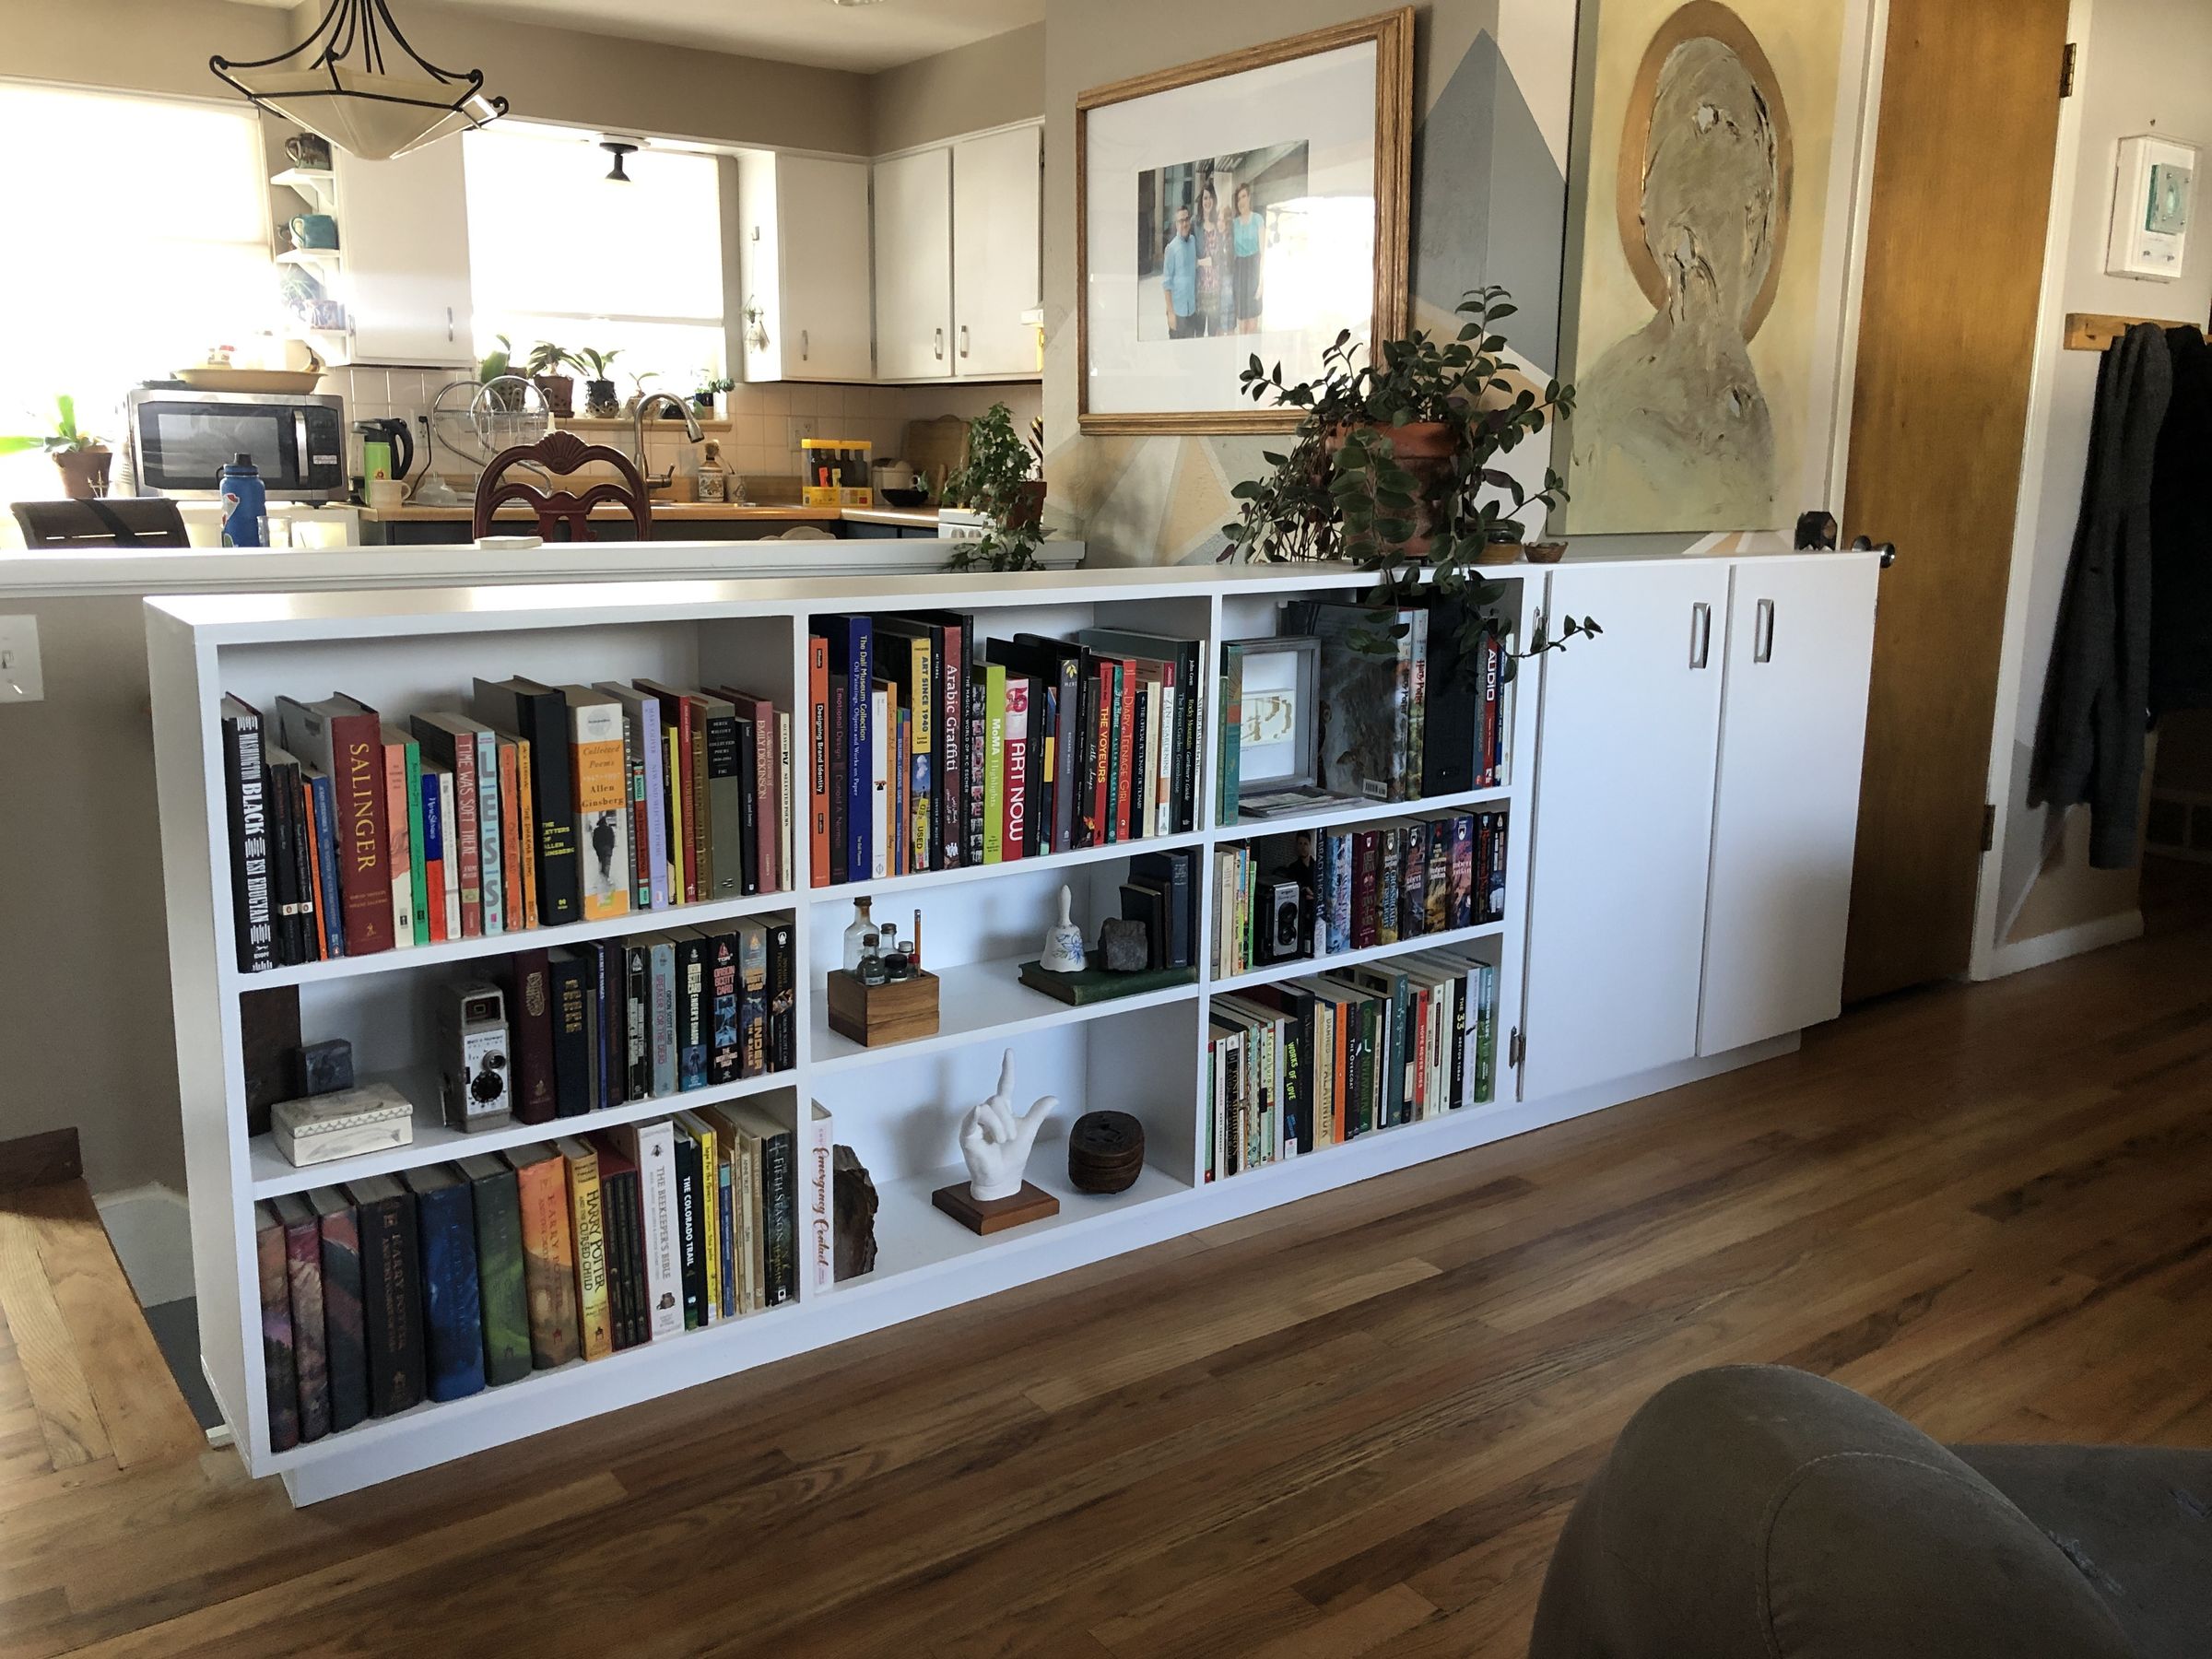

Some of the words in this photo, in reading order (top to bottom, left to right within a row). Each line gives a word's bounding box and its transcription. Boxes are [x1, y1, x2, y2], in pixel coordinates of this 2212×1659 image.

[859, 634, 868, 650] The
[921, 656, 930, 677] ART
[1416, 659, 1426, 681] Harry
[1486, 648, 1496, 701] AUDIO
[859, 667, 867, 702] Museum
[921, 677, 930, 707] SINCE
[946, 664, 959, 713] Arabic
[1415, 681, 1425, 706] Potter
[835, 688, 845, 729] Emotional
[1100, 706, 1110, 728] THE
[1163, 699, 1174, 719] ZEN
[1177, 706, 1185, 728] Forest
[1184, 699, 1194, 718] Rocky
[1400, 690, 1409, 715] Potter
[757, 720, 767, 747] EMILY
[816, 704, 825, 740] Designing
[859, 703, 868, 741] Collection
[921, 709, 930, 733] 1940
[1186, 719, 1194, 749] Mountain
[582, 744, 621, 756] Collected
[834, 730, 843, 759] Design
[946, 716, 959, 772] Graffiti
[991, 718, 1001, 756] MoMA
[1161, 725, 1172, 775] GARDENING
[1175, 728, 1183, 753] Garden
[239, 733, 262, 780] WASHINGTON
[458, 742, 473, 768] TIME
[588, 759, 615, 769] Poems
[782, 751, 790, 766] PAZ
[817, 741, 825, 763] Brand
[1010, 742, 1027, 783] ART
[1098, 732, 1109, 783] VOYEURS
[1120, 733, 1133, 777] TEENAGE
[1184, 750, 1193, 783] Gardener's
[459, 771, 475, 795] WAS
[635, 776, 643, 799] KINNELL
[758, 747, 769, 800] DICKINSON
[816, 764, 825, 793] Identity
[989, 759, 1000, 808] Highlights
[1174, 753, 1182, 794] Greenhouse
[581, 795, 624, 808] Ginsberg
[589, 783, 615, 794] Allen
[835, 773, 844, 805] Donald
[1119, 779, 1131, 804] GIRL
[241, 782, 265, 835] BLACK
[349, 743, 376, 872] SALINGER
[460, 798, 476, 824] SOFT
[1008, 787, 1025, 842] NOW
[462, 829, 477, 857] THERE
[916, 826, 925, 850] USED
[246, 859, 267, 876] ESI
[1317, 841, 1325, 871] BRAD
[247, 877, 269, 923] EDUGYAN
[1317, 871, 1325, 901] THOR
[1389, 869, 1397, 927] CROSSROADS
[655, 973, 665, 1008] SPEAKER
[714, 975, 735, 986] SCOTT
[716, 984, 734, 995] CARD
[656, 1009, 665, 1026] FOR
[689, 994, 699, 1020] ENDER'S
[1456, 1013, 1465, 1030] 33
[657, 1027, 665, 1042] THE
[754, 1017, 764, 1070] ENDER
[657, 1043, 665, 1065] DEAD
[1288, 1041, 1299, 1068] WORKS
[1288, 1070, 1297, 1080] OF
[1347, 1054, 1356, 1090] OVERCOAT
[1286, 1081, 1297, 1101] LOVE
[704, 1147, 712, 1161] hope
[656, 1165, 665, 1188] THE
[682, 1176, 691, 1194] THE
[772, 1157, 786, 1192] FIFTH
[812, 1146, 830, 1215] Emergency
[586, 1189, 603, 1236] HARRY
[657, 1189, 670, 1253] BEEKEEPER'S
[684, 1194, 694, 1241] COLORADO
[774, 1193, 786, 1242] SEASON
[579, 1222, 591, 1259] CURSED
[686, 1241, 695, 1267] TRAIL
[812, 1218, 830, 1267] Contact
[582, 1261, 594, 1291] CHILD
[591, 1239, 606, 1293] POTTER
[661, 1253, 671, 1280] BIBLE
